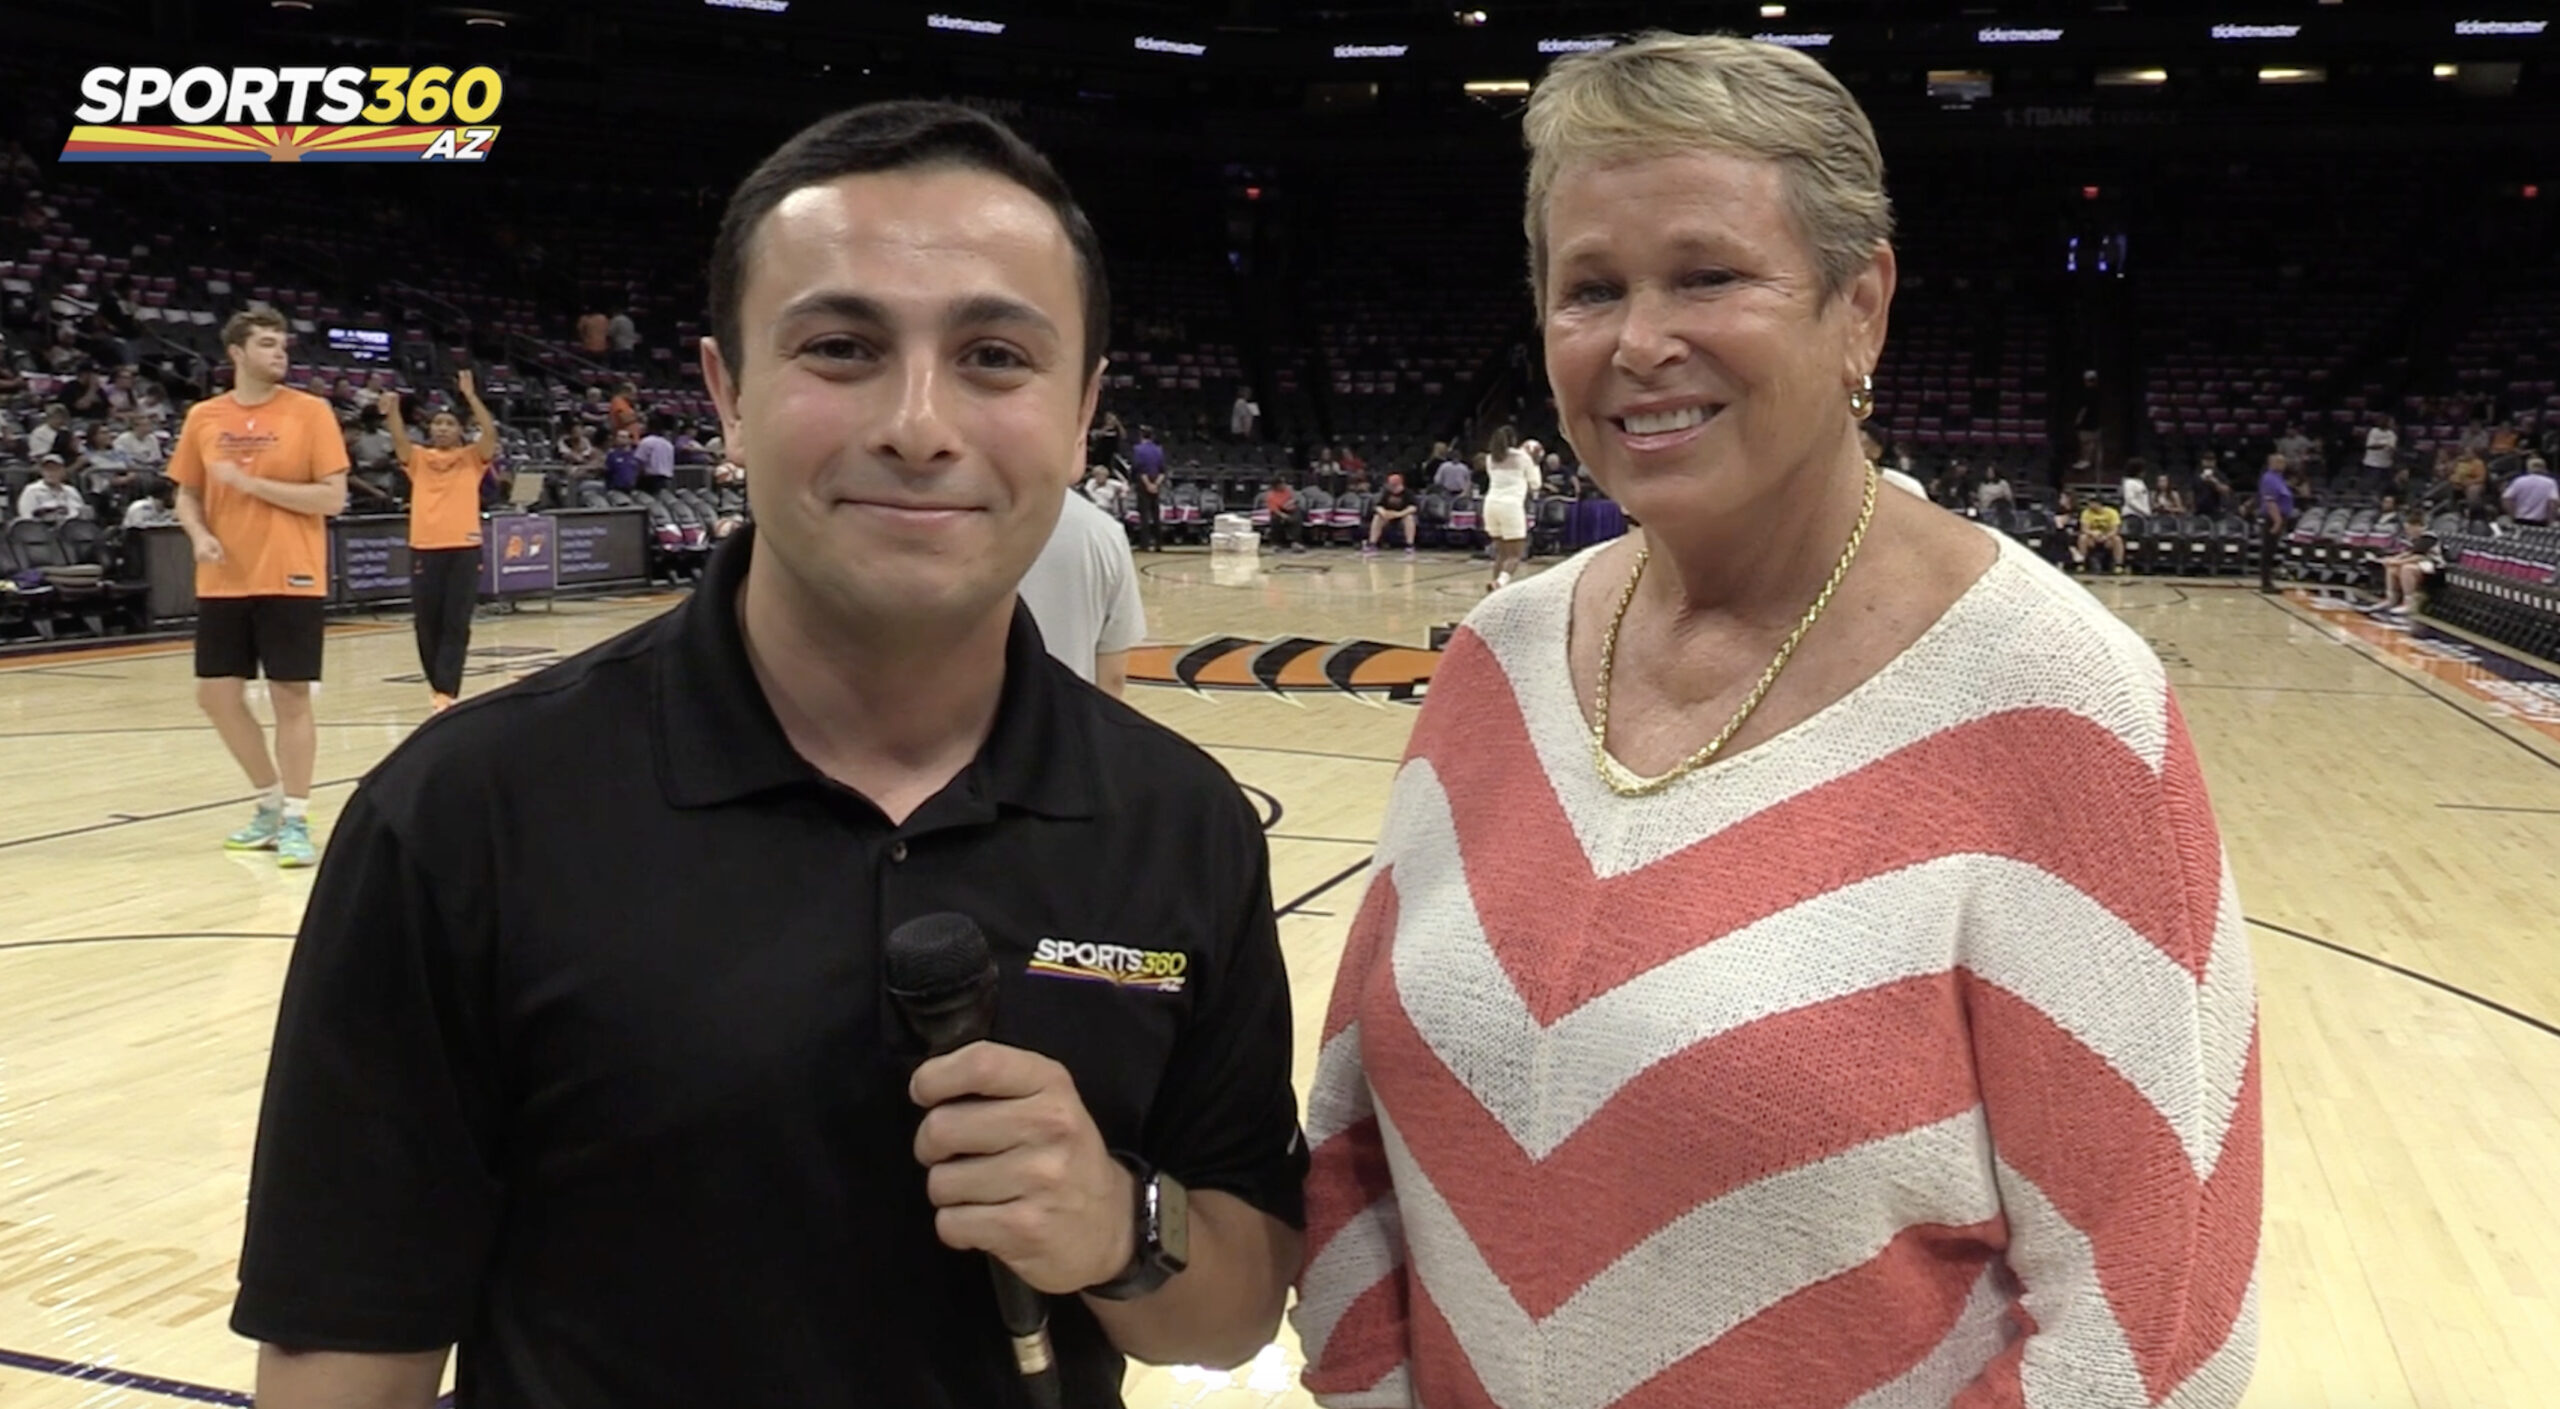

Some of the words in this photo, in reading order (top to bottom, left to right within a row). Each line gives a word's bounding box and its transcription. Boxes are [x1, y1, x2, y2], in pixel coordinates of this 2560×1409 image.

[927, 13, 1006, 34] ticketmaster
[2211, 24, 2302, 38] ticketmaster
[2455, 20, 2549, 35] ticketmaster
[1978, 27, 2064, 42] ticketmaster
[1134, 36, 1207, 56] ticketmaster
[1333, 44, 1409, 58] ticketmaster
[1033, 937, 1188, 976] SPORTS360
